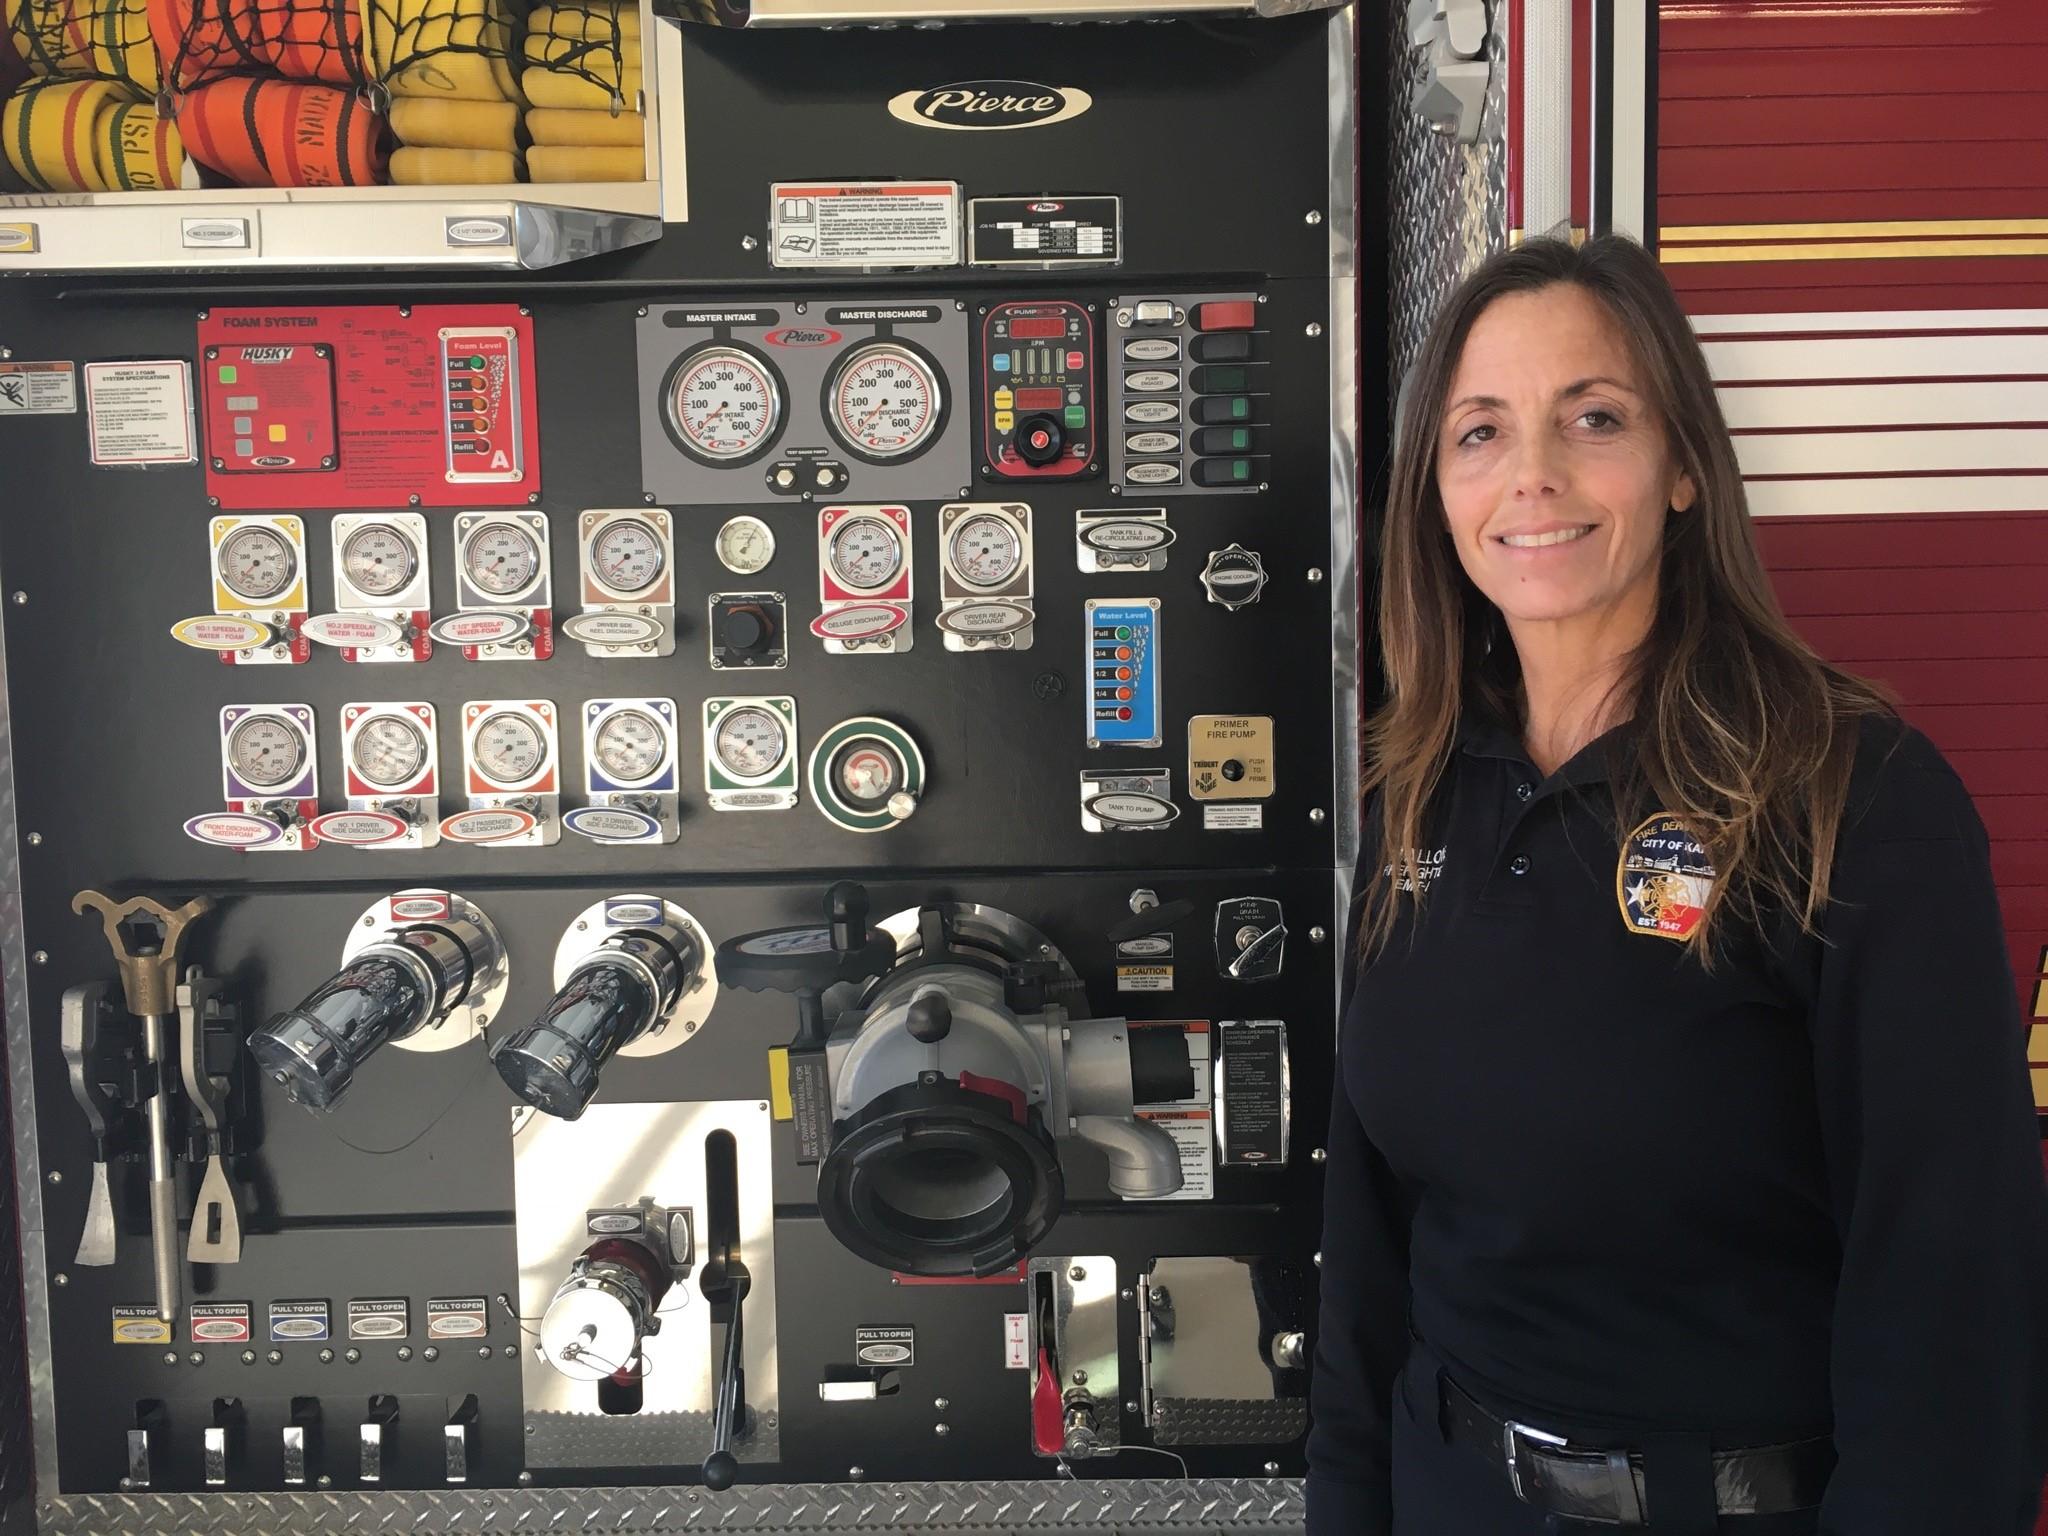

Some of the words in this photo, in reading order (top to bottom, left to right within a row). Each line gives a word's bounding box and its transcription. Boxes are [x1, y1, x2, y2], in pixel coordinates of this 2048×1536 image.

[924, 90, 1057, 117] Pierce
[124, 114, 153, 155] PSI
[849, 187, 883, 196] WARNING
[686, 314, 723, 322] MASTER
[724, 313, 757, 321] INTAKE
[840, 311, 876, 319] MASTER
[878, 310, 928, 319] DISCHARGE
[223, 317, 260, 328] FOAM
[263, 316, 318, 327] SYSTEM
[784, 329, 825, 343] Pierce
[480, 341, 502, 349] Level
[243, 347, 291, 359] HUSKY
[715, 371, 734, 381] 300
[876, 369, 894, 379] 300
[450, 381, 462, 389] 3/4
[698, 380, 717, 390] 200
[733, 382, 752, 391] 400
[858, 378, 877, 388] 200
[893, 379, 912, 389] 400
[691, 399, 708, 409] 100
[739, 401, 758, 411] 500
[851, 397, 868, 406] 100
[899, 398, 918, 408] 500
[453, 422, 465, 430] 1/4
[732, 421, 750, 430] 600
[892, 418, 910, 428] 600
[454, 443, 474, 451] Refill
[490, 450, 510, 469] A
[1224, 553, 1243, 561] OPEN
[964, 613, 986, 621] DRIVER
[987, 611, 1007, 619] REAR
[343, 622, 377, 631] SPEEDLAY
[471, 621, 505, 629] SPEEDLAY
[827, 619, 853, 630] DELUGE
[853, 614, 891, 625] DISCHARGE
[966, 618, 1004, 626] DISCHARGE
[212, 625, 246, 633] SPEEDLAY
[328, 629, 349, 637] WATER
[355, 630, 376, 638] FOAM
[457, 626, 501, 636] WATER-FOAM
[196, 632, 217, 640] WATER
[224, 633, 244, 641] FOAM
[1214, 720, 1249, 728] PRIMER
[1207, 730, 1228, 739] FIRE
[1230, 730, 1256, 738] PUMP
[1201, 772, 1212, 784] AIR
[1195, 779, 1217, 794] PRIME
[1108, 803, 1124, 811] TANK
[476, 818, 513, 827] PASSENGER
[586, 820, 600, 828] SIDE
[601, 822, 639, 832] DISCHARGE
[610, 818, 634, 826] DRIVER
[203, 823, 223, 831] FRONT
[224, 824, 262, 833] DISCHARGE
[475, 824, 512, 833] DISCHARGE
[212, 830, 254, 838] WATER-FOAM
[1635, 826, 1658, 841] FIRE
[1641, 839, 1666, 849] CITY
[1667, 841, 1683, 850] OF
[1637, 917, 1657, 927] EST.
[1660, 920, 1682, 931] 1947
[1132, 967, 1167, 975] CAUTION
[225, 1307, 246, 1315] OPEN
[351, 1304, 371, 1312] PULL
[382, 1303, 404, 1311] OPEN
[430, 1303, 450, 1311] PULL
[450, 1302, 461, 1310] TO
[859, 1331, 879, 1339] PULL
[890, 1330, 911, 1338] OPEN
